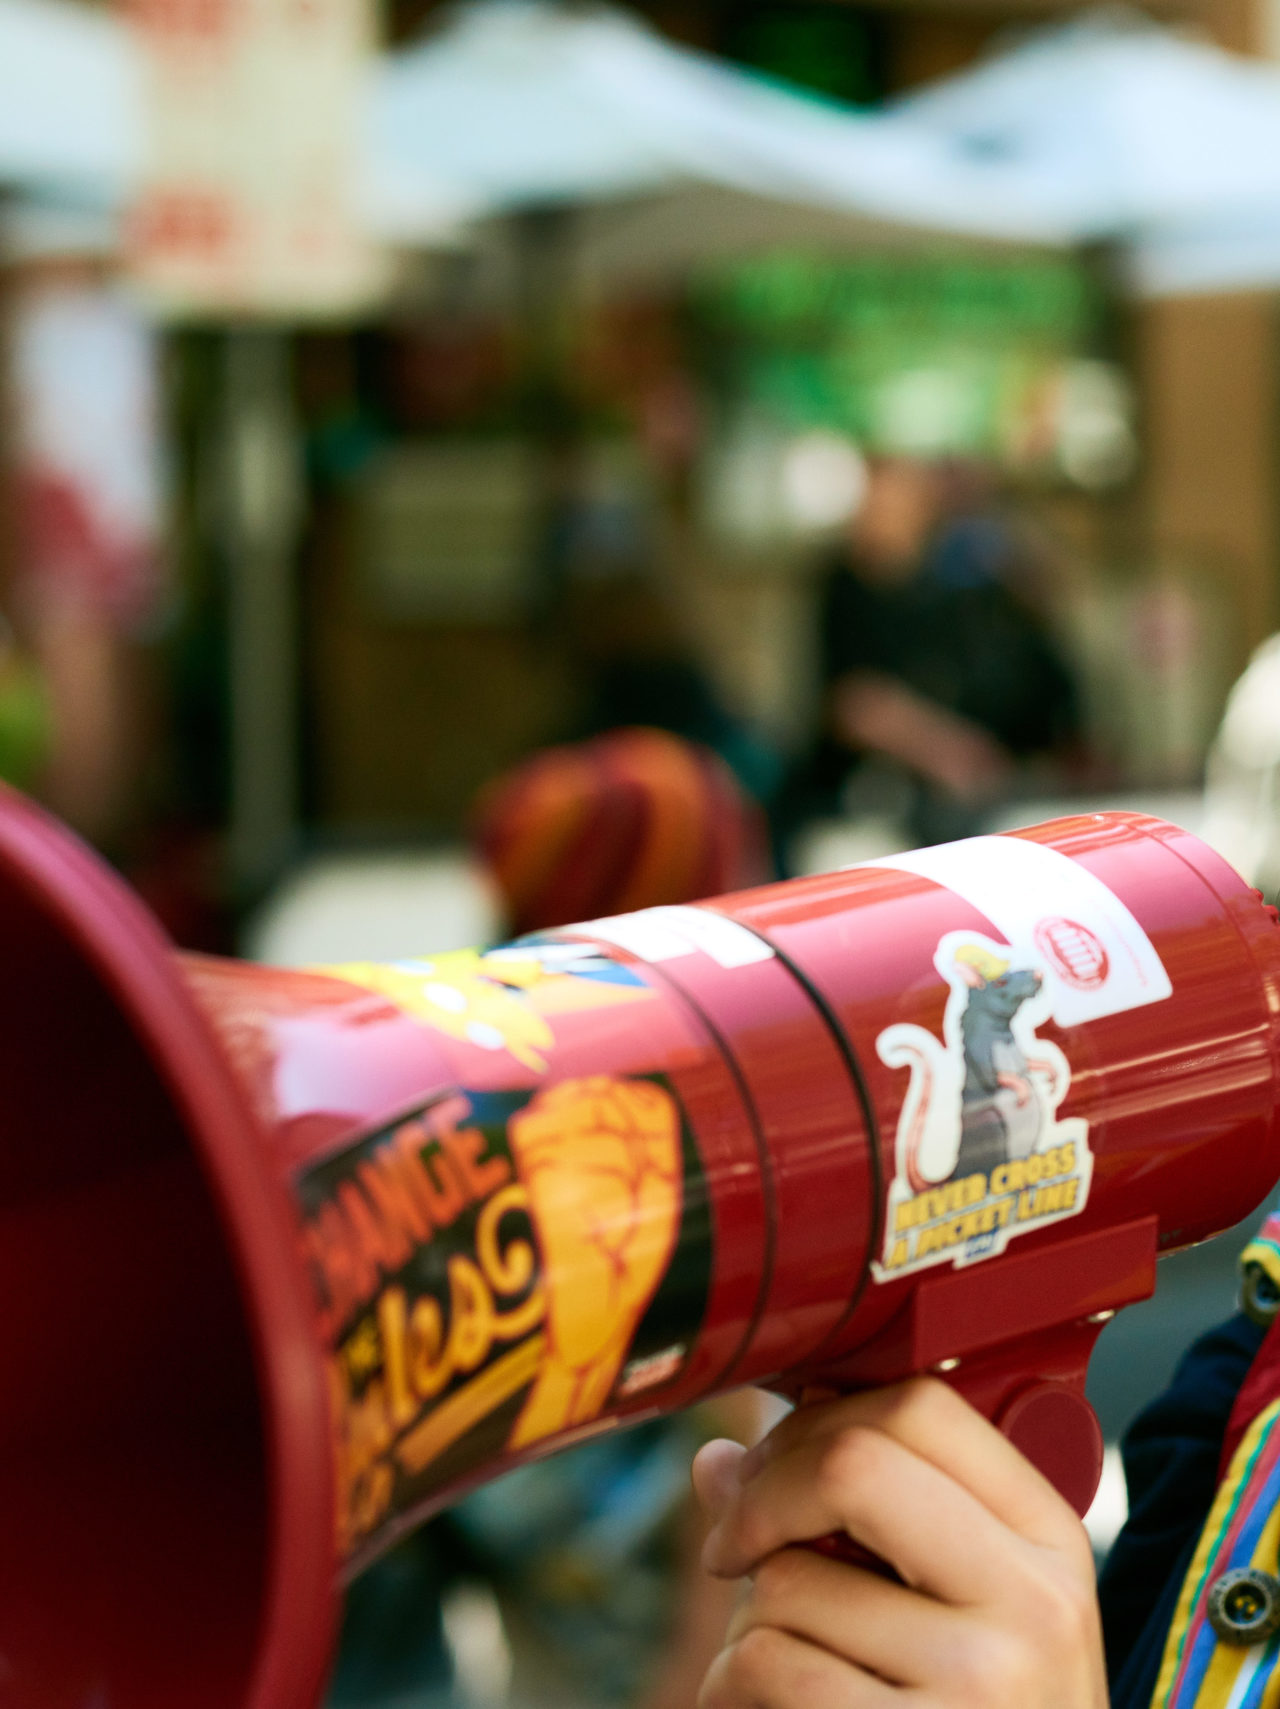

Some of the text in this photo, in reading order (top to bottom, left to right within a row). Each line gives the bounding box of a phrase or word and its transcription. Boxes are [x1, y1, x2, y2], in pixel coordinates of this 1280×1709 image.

[882, 1238, 909, 1270] A
[913, 1196, 1016, 1261] PICKET
[1014, 1177, 1081, 1222] LINE
[894, 1139, 1077, 1232] NEVER CROSS
